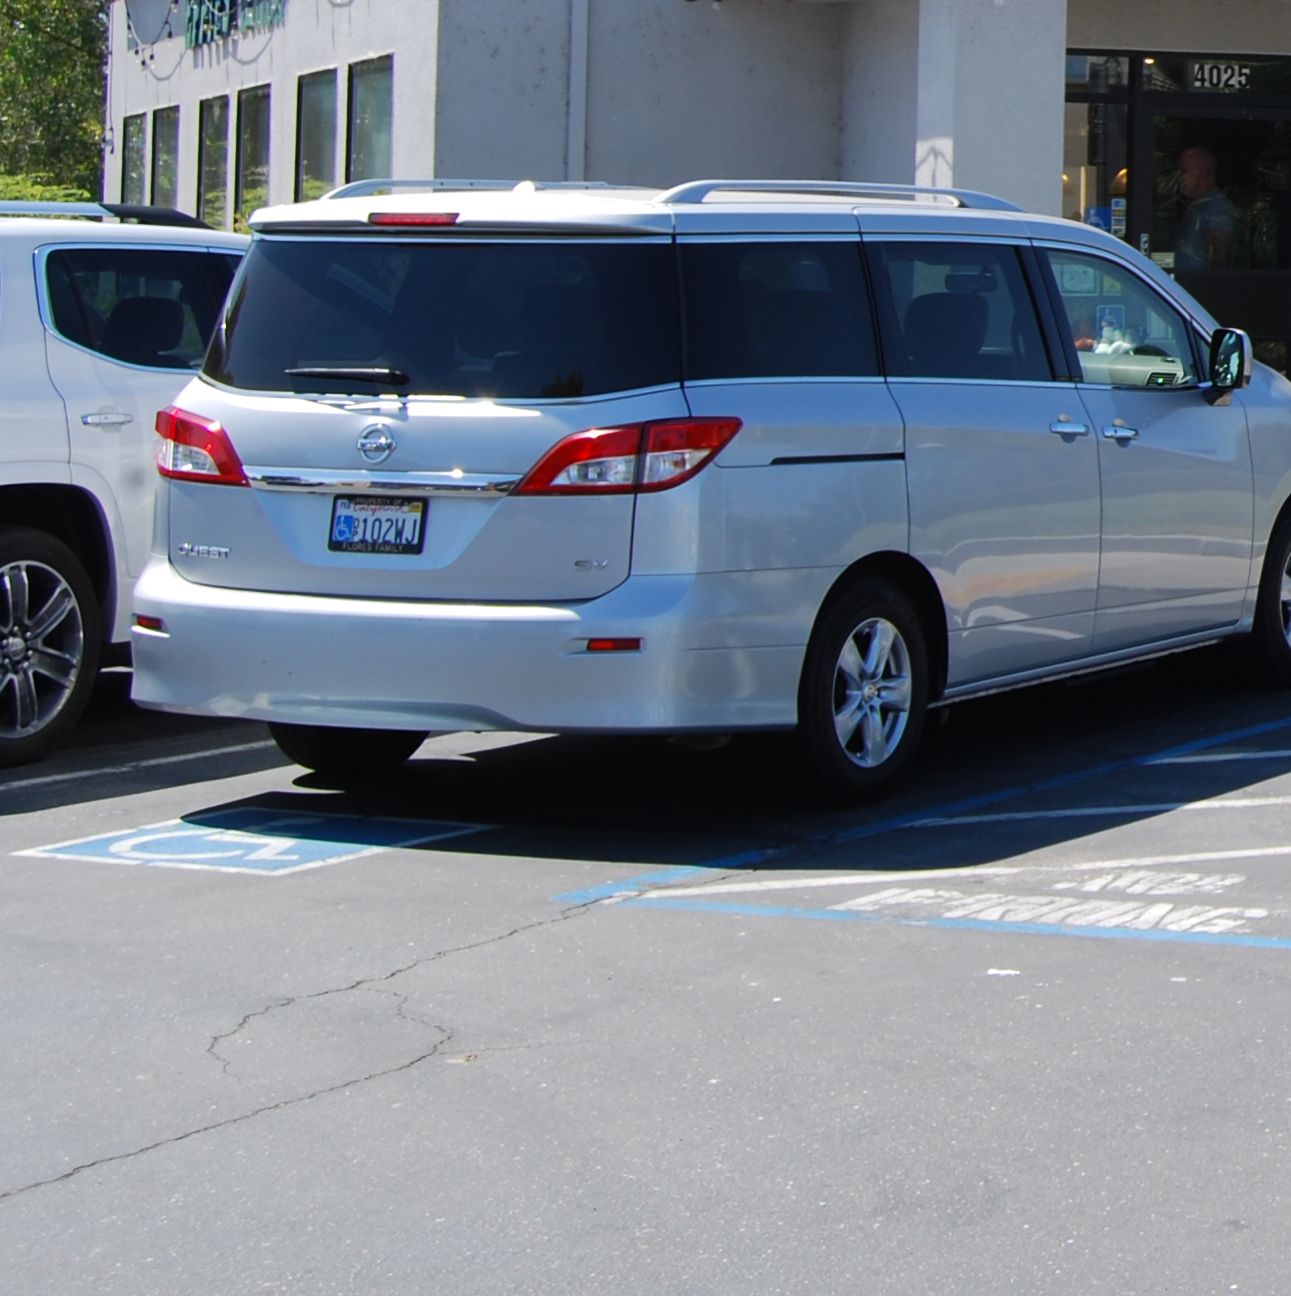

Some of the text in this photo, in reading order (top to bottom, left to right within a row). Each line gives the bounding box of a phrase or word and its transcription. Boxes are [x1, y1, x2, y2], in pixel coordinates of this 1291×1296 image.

[1195, 64, 1250, 88] 4025
[362, 517, 418, 545] 102WJ
[342, 542, 404, 553] FLORES FAMILY
